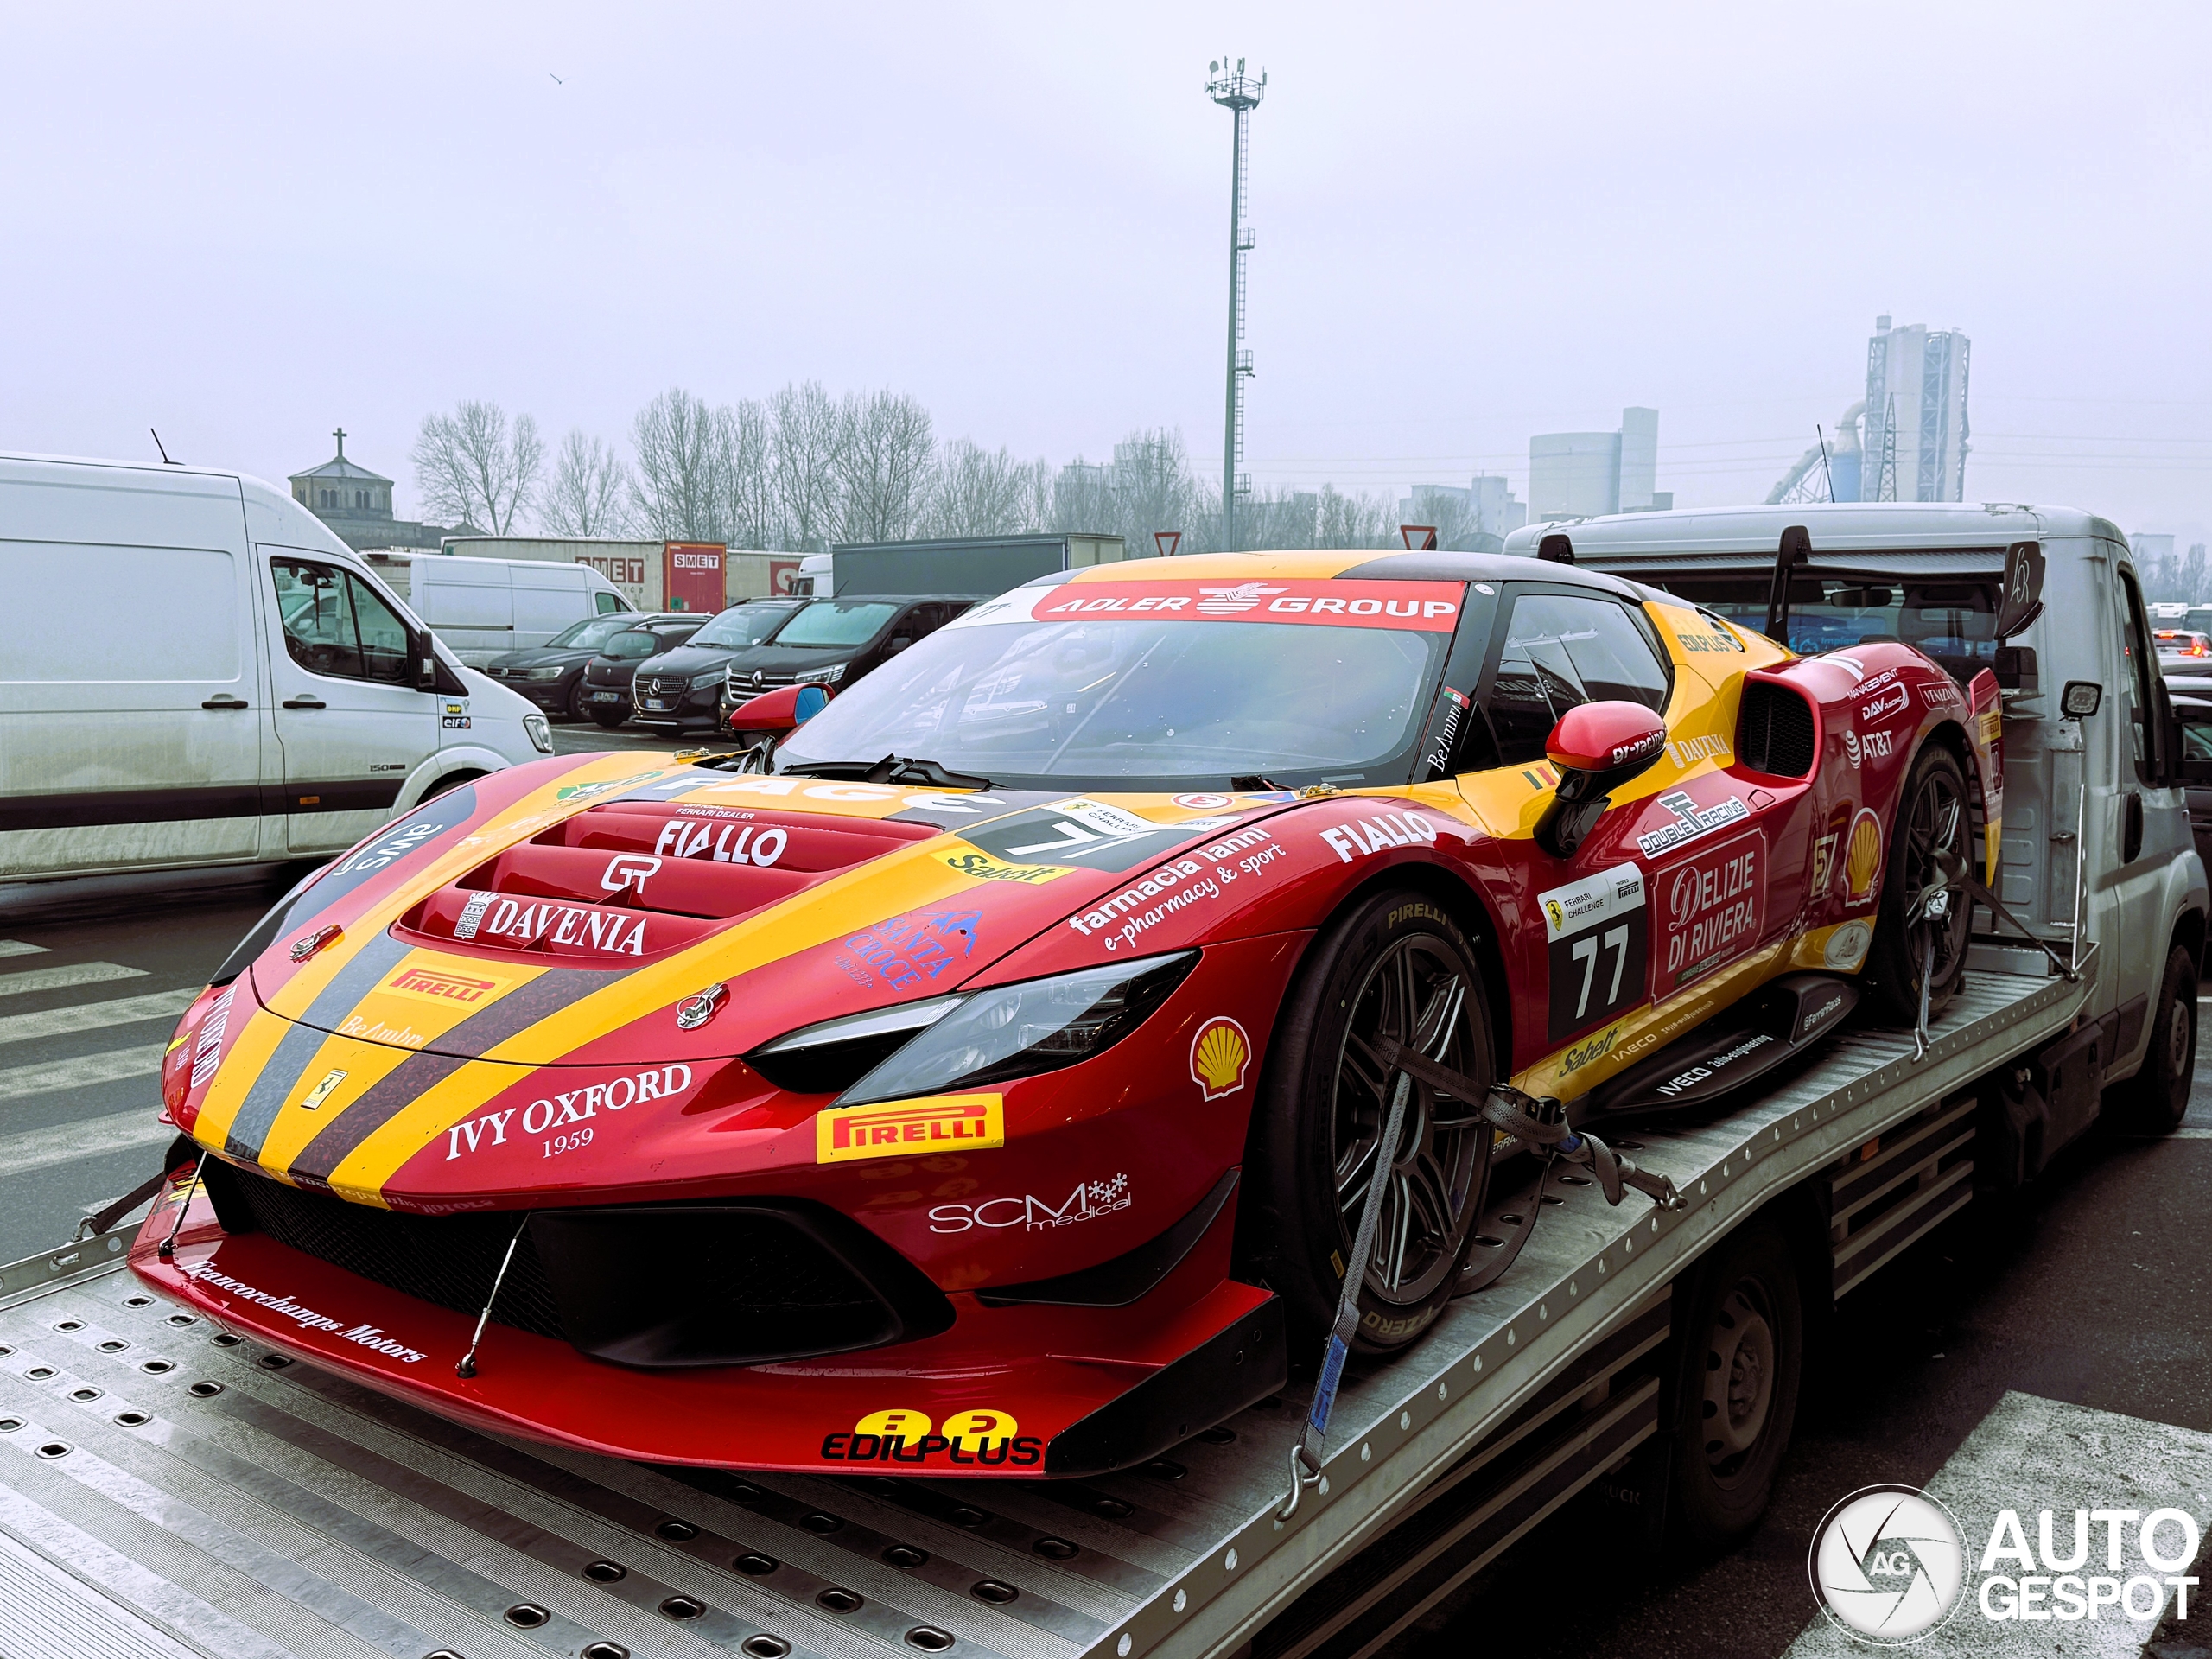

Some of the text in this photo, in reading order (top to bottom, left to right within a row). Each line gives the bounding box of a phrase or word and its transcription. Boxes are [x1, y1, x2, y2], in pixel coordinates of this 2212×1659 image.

[676, 555, 718, 568] SMET
[1047, 596, 1456, 618] ADLER GROUP
[1677, 634, 1730, 652] EDILPLUS
[1847, 668, 1898, 700] MANAGEMENT
[444, 718, 461, 728] elf
[447, 704, 461, 714] OMP
[1862, 696, 1885, 721] DAV
[1612, 728, 1667, 764] gr-racing
[1677, 734, 1731, 762] DAVENIA
[1862, 730, 1892, 760] AT&T
[676, 808, 755, 820] FERRARI DEALER
[655, 820, 787, 868] FIALLO
[1319, 811, 1437, 863] FIALLO
[1641, 822, 1693, 852] DOUBLE
[1069, 827, 1272, 936] farmacia ianni
[1103, 842, 1287, 952] e-pharmacy & sport
[1618, 880, 1640, 899] PIRELLI
[1388, 903, 1447, 930] PIRELLI
[1564, 892, 1592, 909] FERRARI
[1568, 899, 1605, 919] CHALLENGE
[486, 899, 647, 956] DAVENIA
[1668, 930, 1687, 973] DI
[1690, 896, 1753, 961] RIVIERA
[845, 934, 922, 991] CROCE
[873, 917, 955, 979] SANTA
[389, 968, 496, 1002] PIRELLI
[1573, 923, 1629, 1019] 77
[1803, 995, 1841, 1031] @FerrariRaces
[1559, 1026, 1618, 1077] Sabelt
[1656, 1066, 1713, 1096] IVECO
[445, 1063, 692, 1161] IVY OXFORD
[833, 1105, 987, 1149] PIRELLI
[543, 1128, 594, 1159] 1959
[928, 1183, 1086, 1233] SCM
[1027, 1192, 1131, 1232] medical
[179, 1260, 429, 1364] Francorchamps Motors
[820, 1433, 1044, 1465] EDILPLUS
